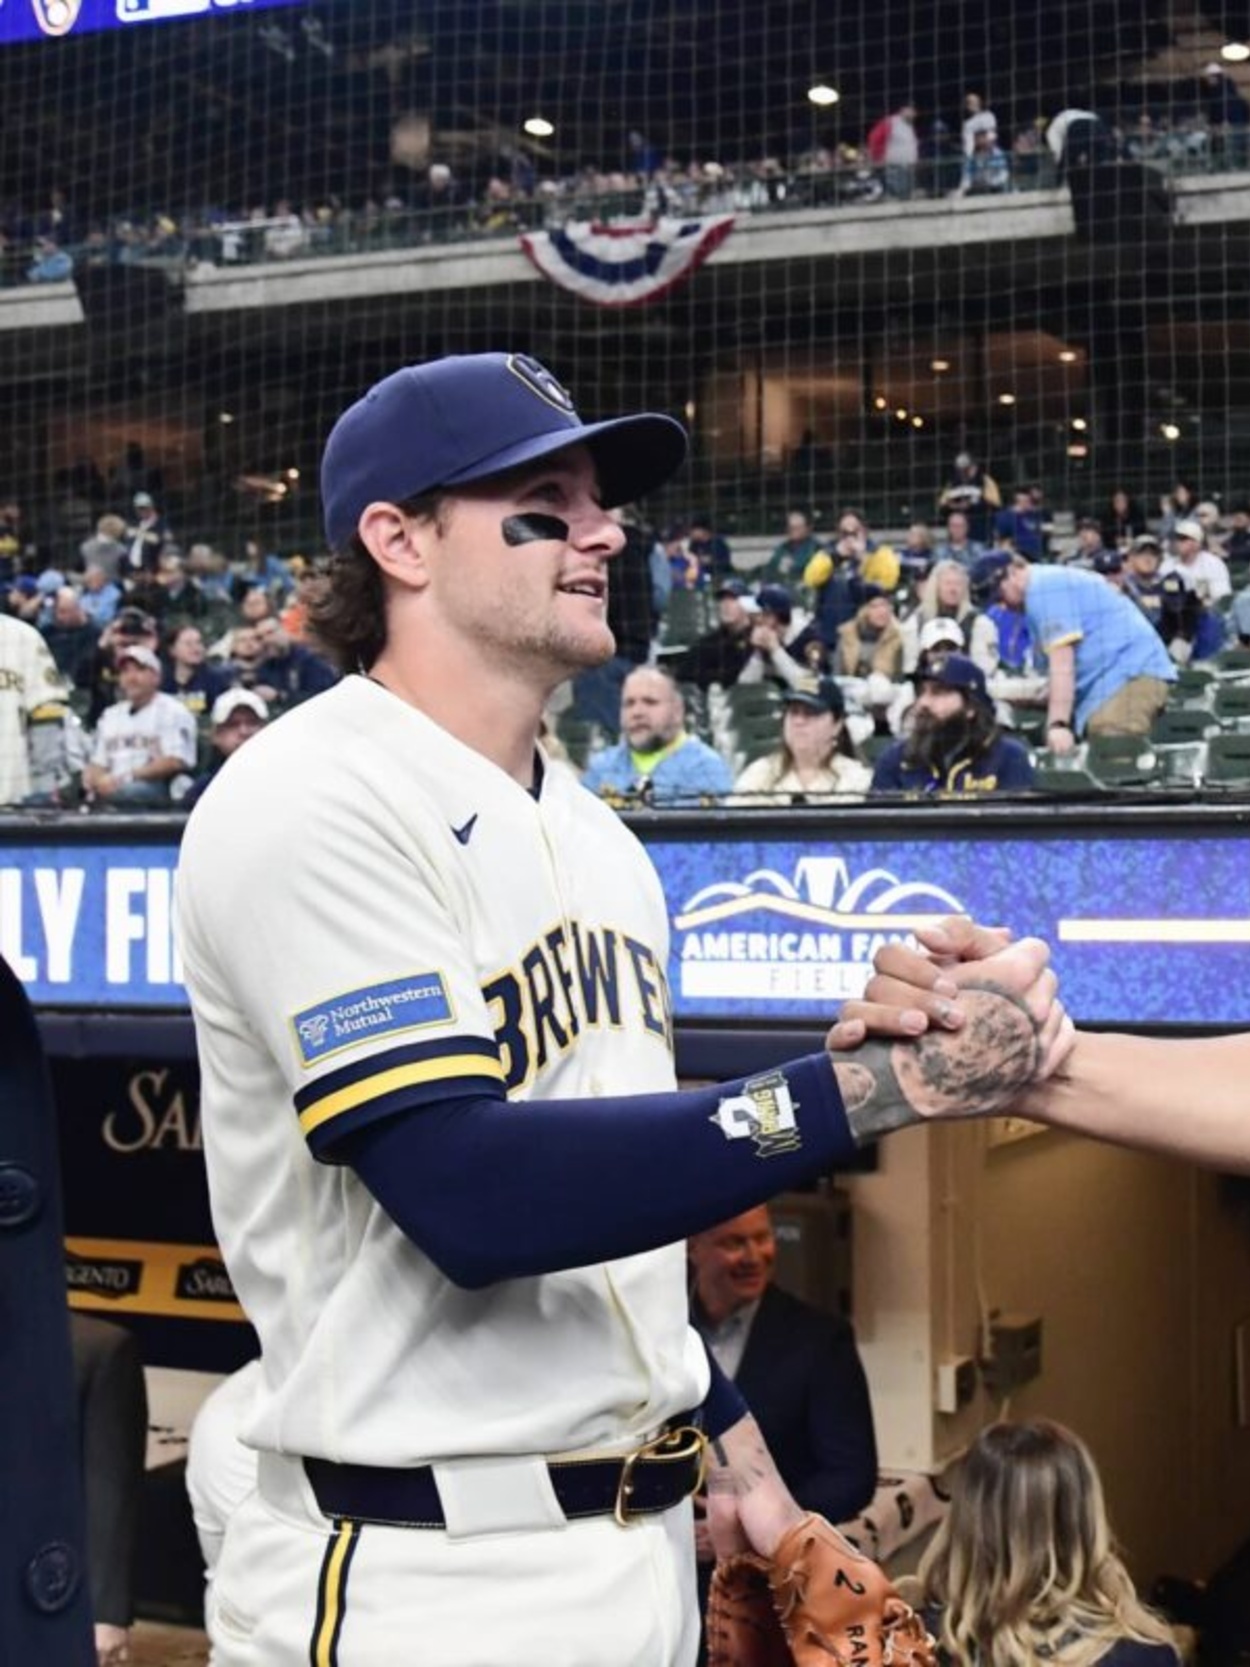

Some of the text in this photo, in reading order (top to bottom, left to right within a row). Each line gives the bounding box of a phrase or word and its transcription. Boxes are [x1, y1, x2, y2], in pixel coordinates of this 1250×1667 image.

[106, 867, 185, 984] FI
[681, 932, 842, 961] AMERICAN
[769, 967, 874, 993] FIEL
[331, 986, 441, 1021] Northwestern
[334, 1007, 393, 1036] Mutual
